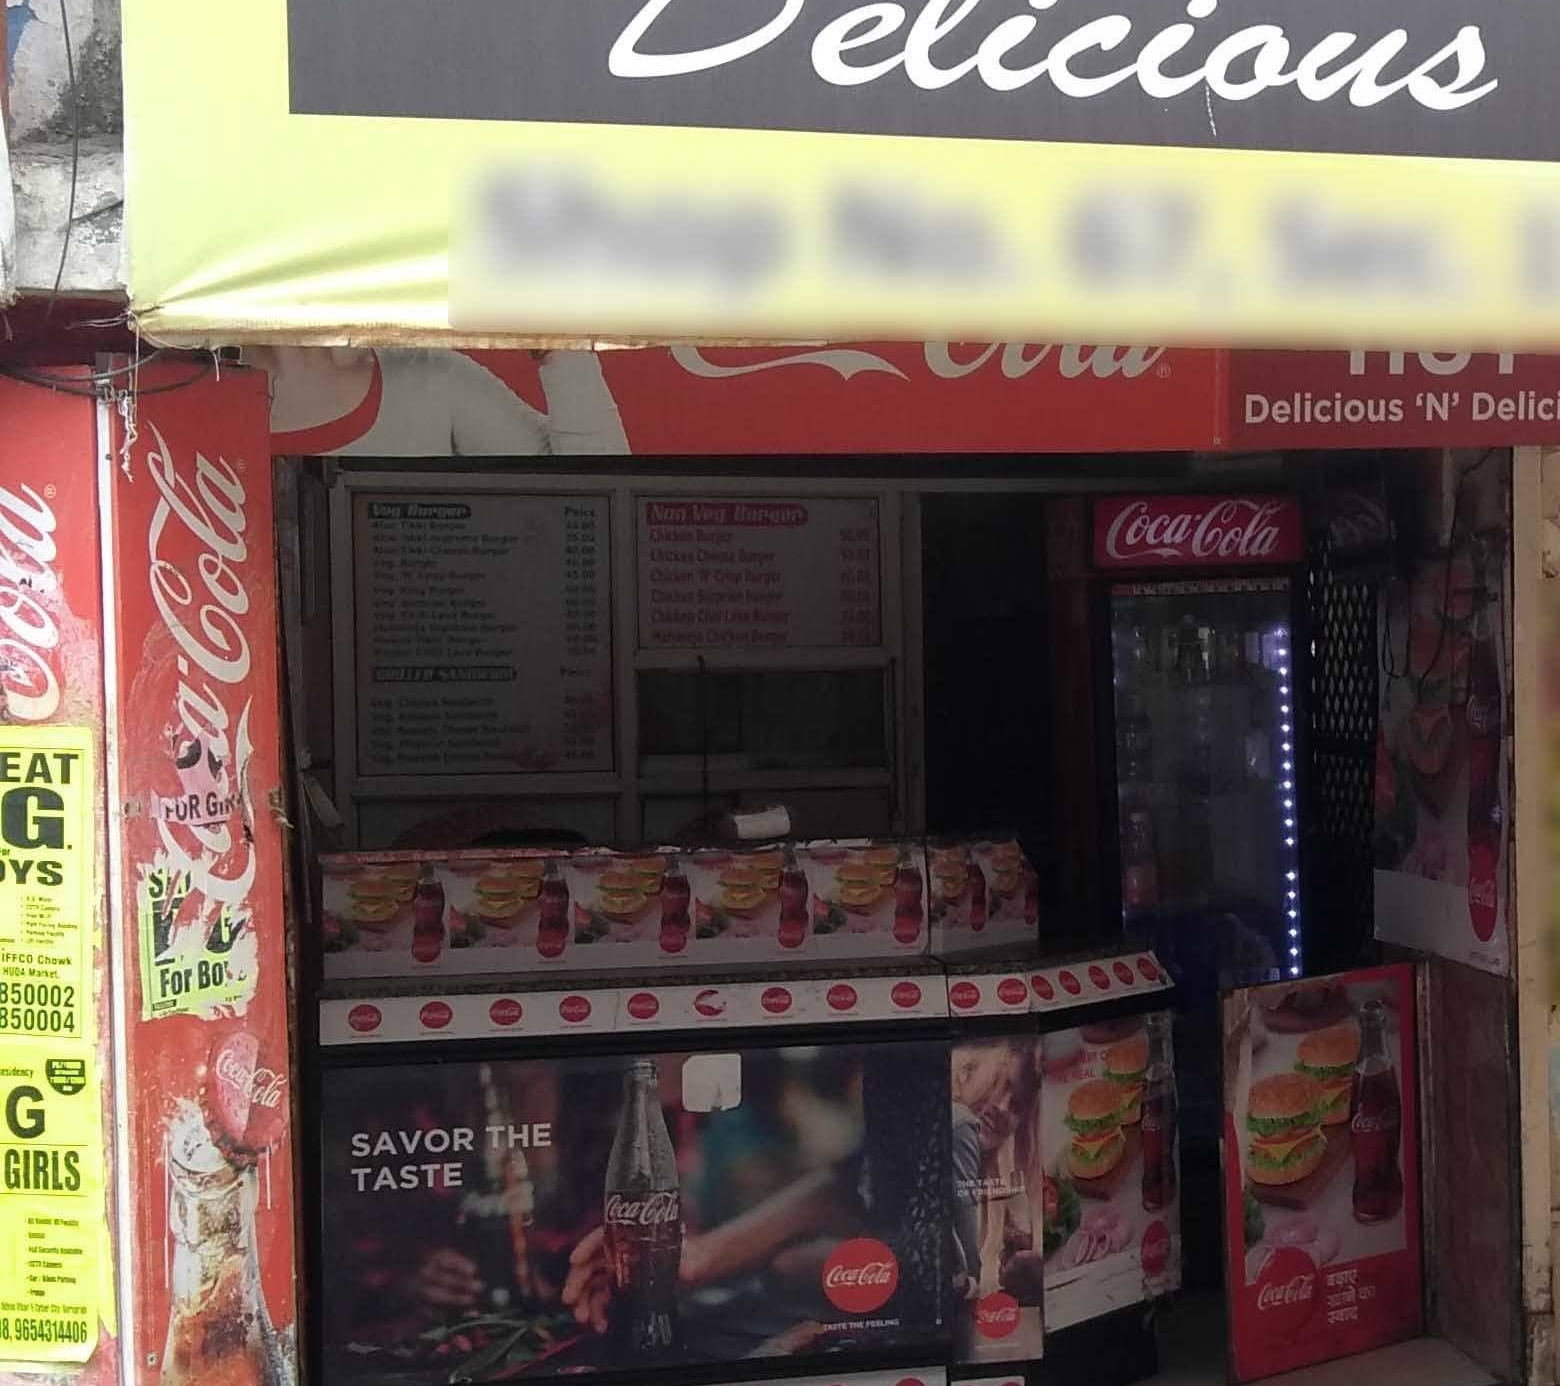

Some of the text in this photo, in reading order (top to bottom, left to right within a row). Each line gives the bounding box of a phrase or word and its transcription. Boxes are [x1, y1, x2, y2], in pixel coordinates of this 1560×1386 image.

[1244, 391, 1405, 424] Delicious
[1105, 498, 1288, 560] Coca-Cola
[351, 1123, 553, 1158] SAVOR THE
[4, 1148, 81, 1192] GIRLS
[350, 1162, 464, 1192] TASTE
